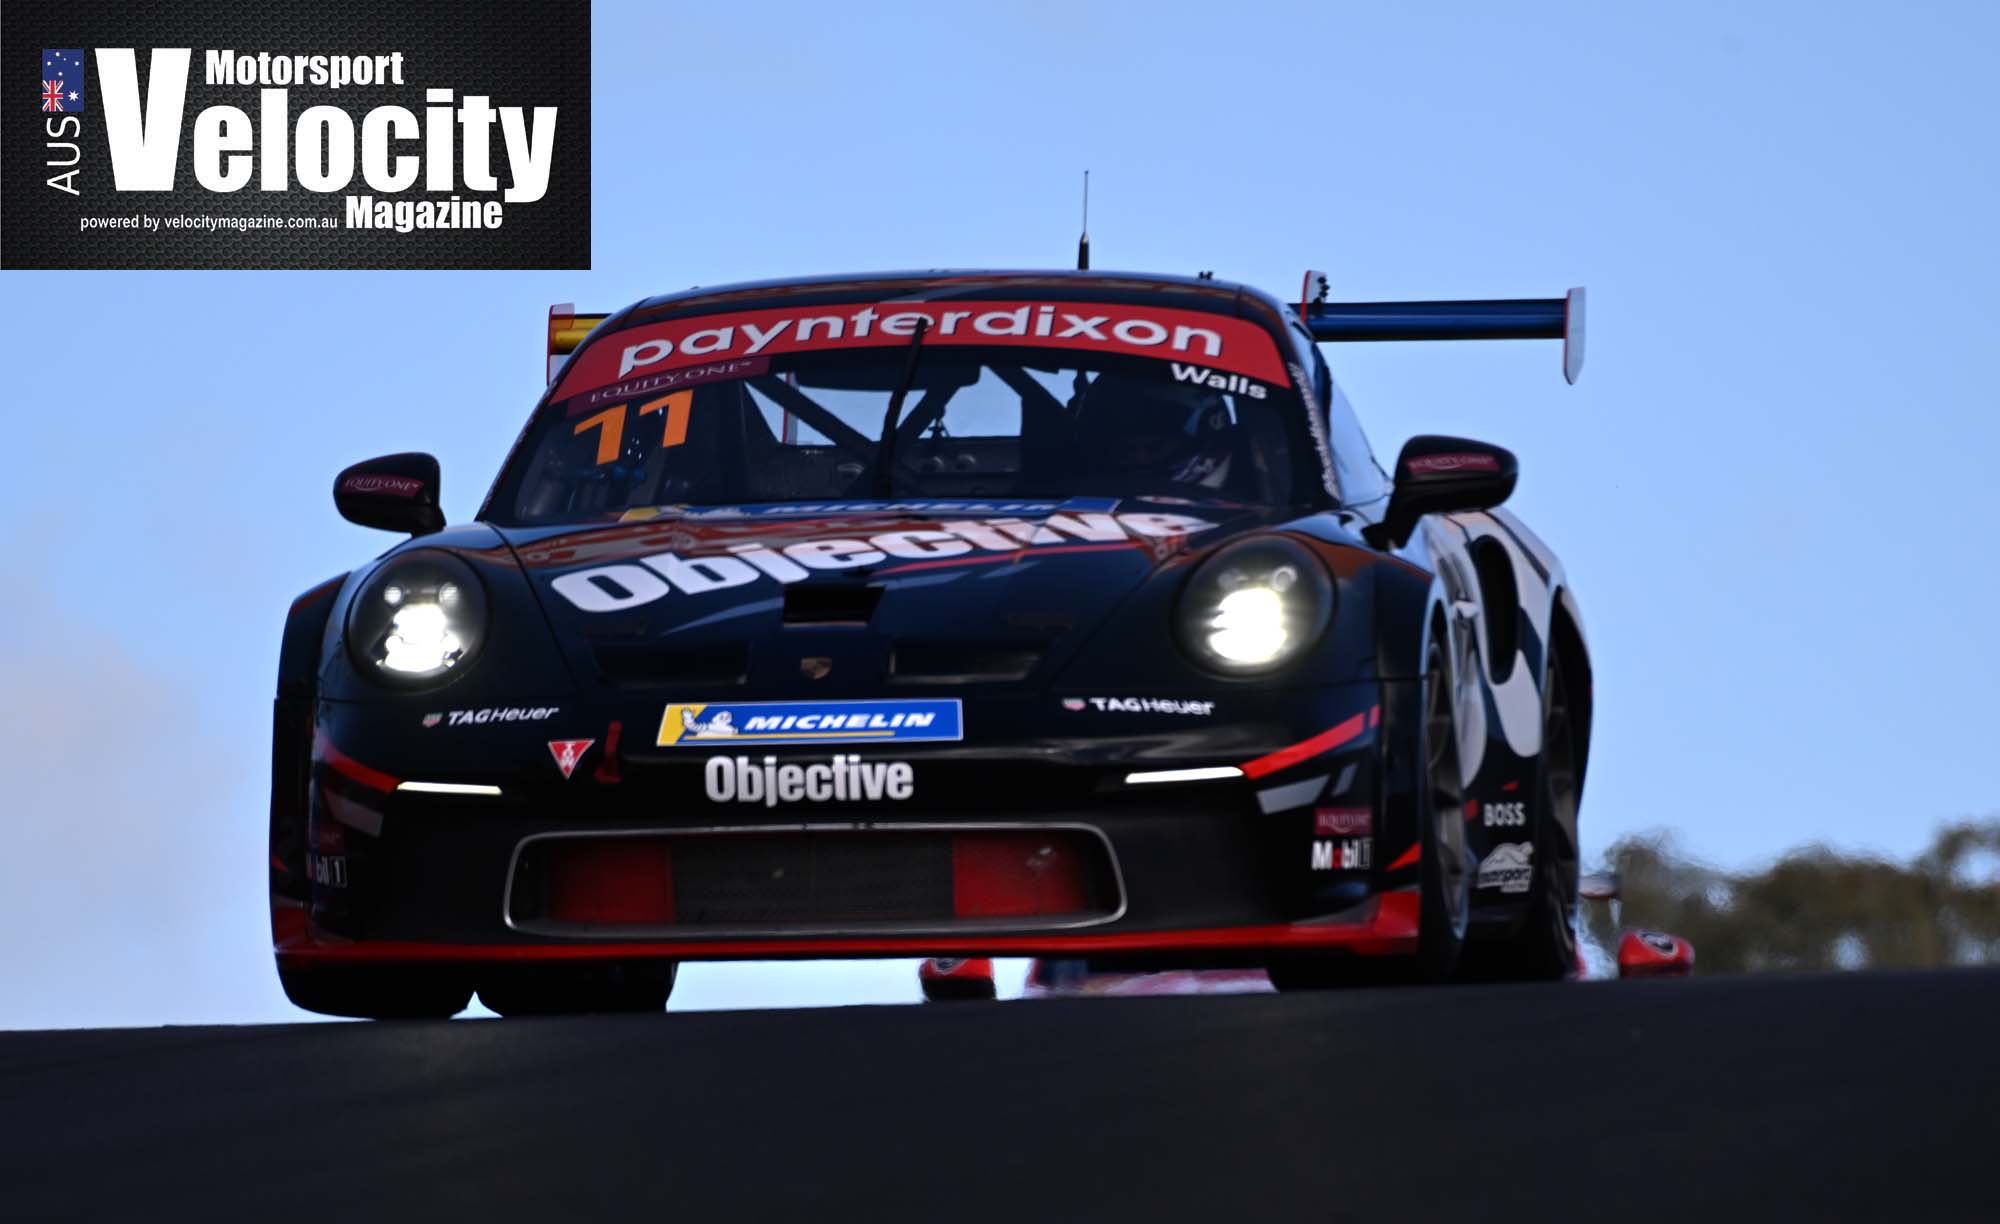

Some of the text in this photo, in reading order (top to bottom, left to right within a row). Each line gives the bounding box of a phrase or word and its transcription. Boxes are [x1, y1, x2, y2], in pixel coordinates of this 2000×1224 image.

[618, 304, 1223, 378] paynterdixon
[590, 373, 682, 404] EQUITY
[1170, 362, 1268, 400] Walls
[573, 388, 694, 465] 11
[550, 511, 1218, 613] Objective
[744, 712, 936, 731] MICHELIN
[705, 754, 914, 808] Objective
[1484, 801, 1526, 827] BOSS
